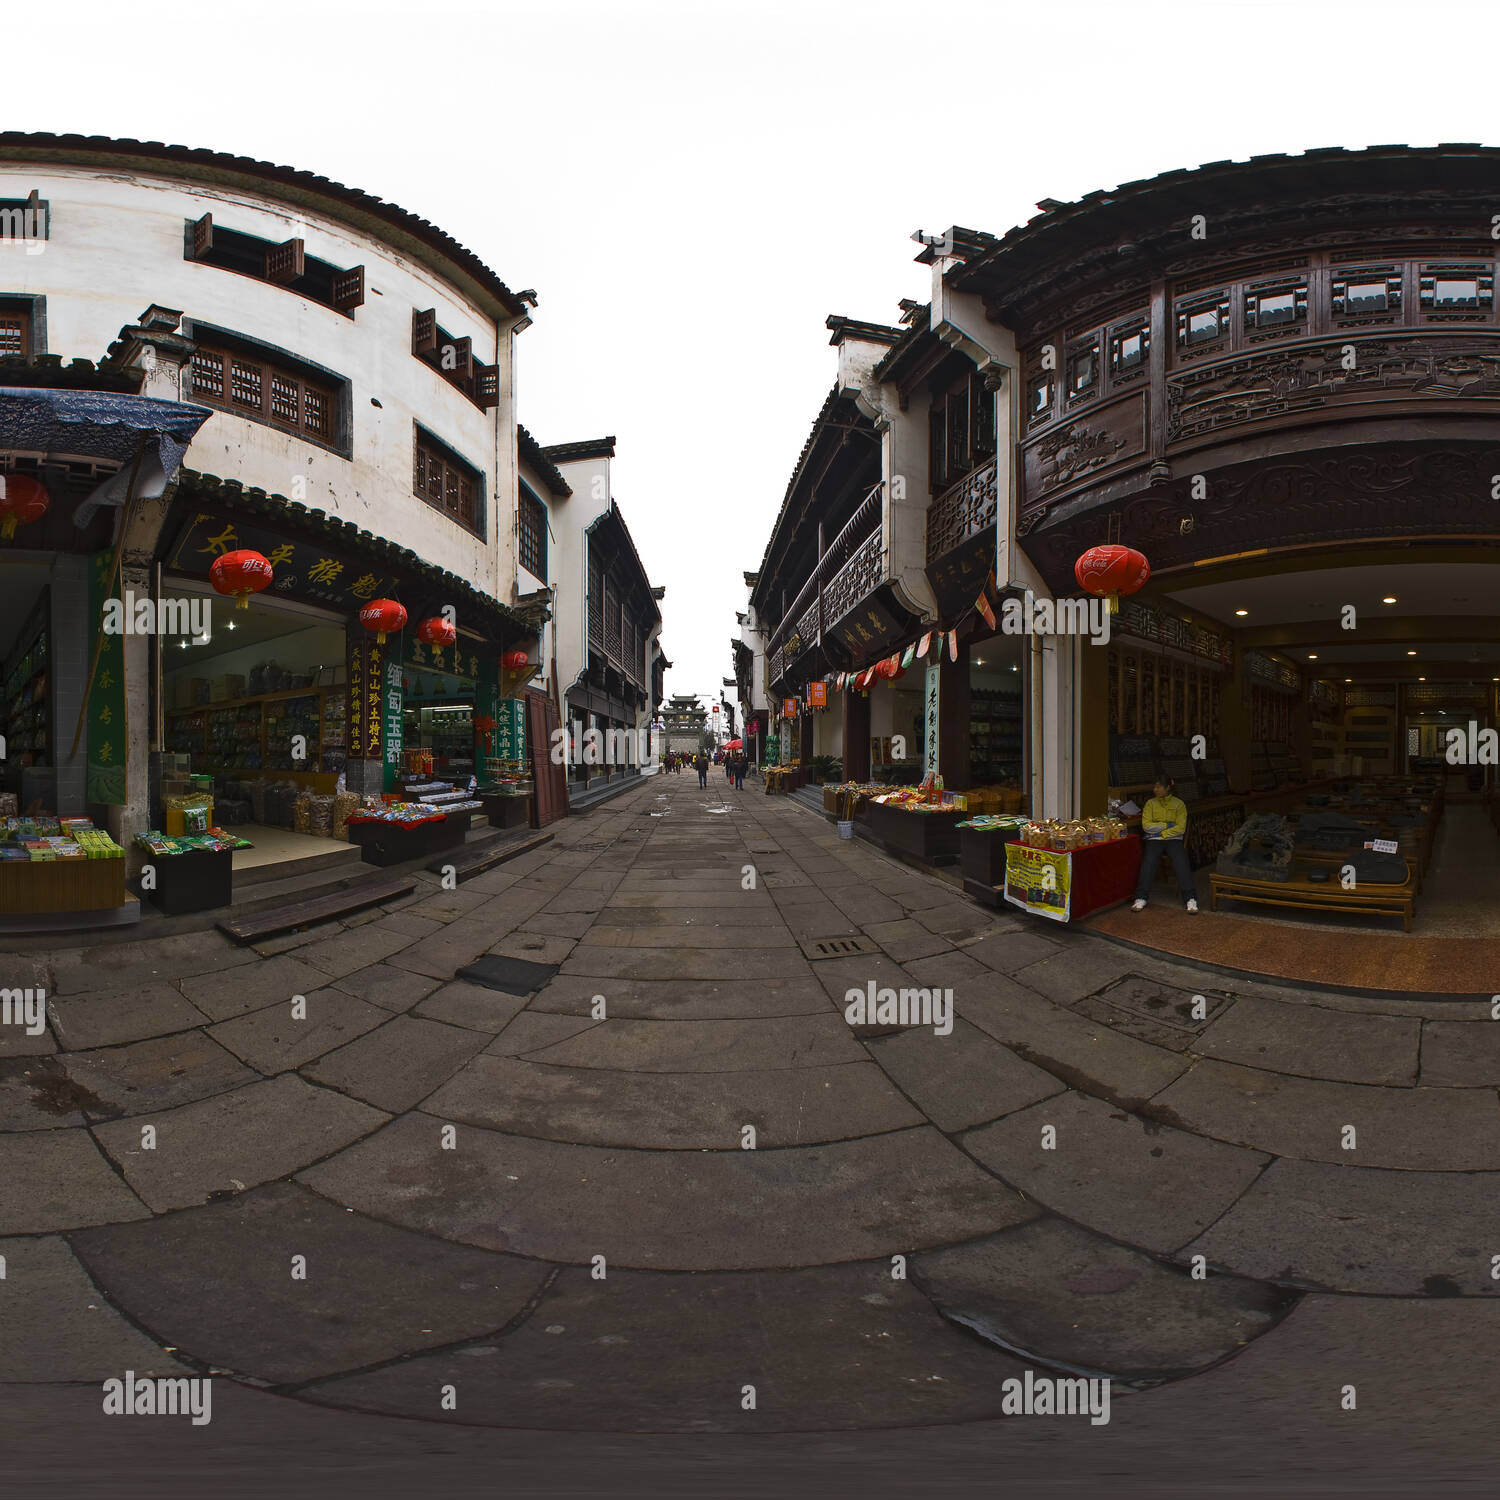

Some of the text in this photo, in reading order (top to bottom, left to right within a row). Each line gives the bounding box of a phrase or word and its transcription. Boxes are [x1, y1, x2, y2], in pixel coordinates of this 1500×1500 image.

[368, 648, 381, 751] 黄山山珍土特产
[387, 662, 403, 763] 缅甸玉器
